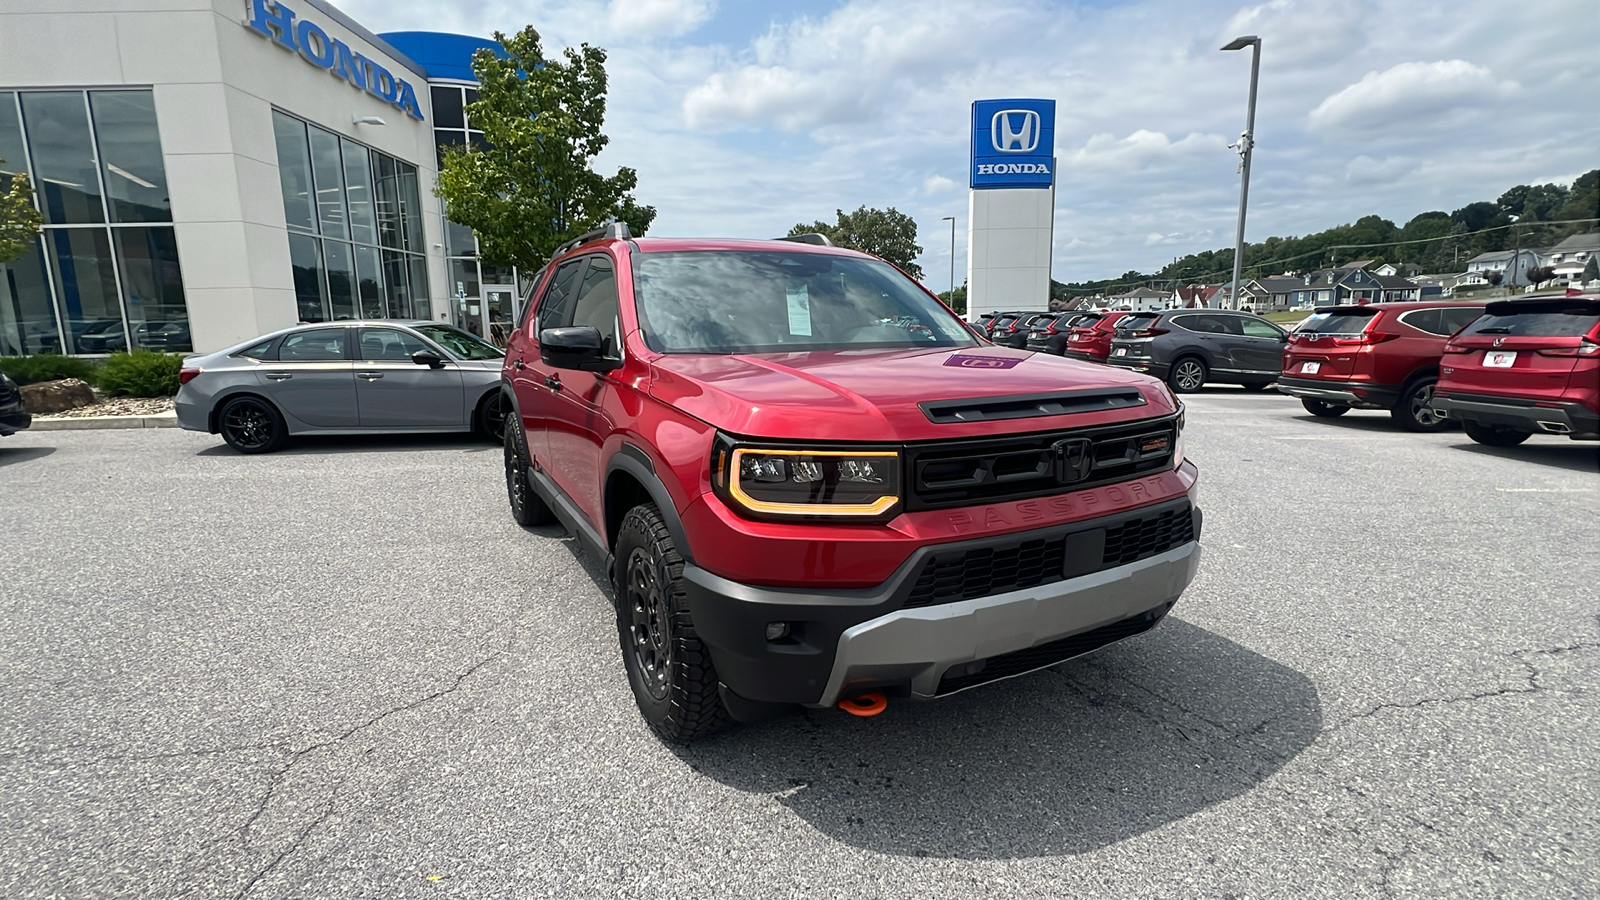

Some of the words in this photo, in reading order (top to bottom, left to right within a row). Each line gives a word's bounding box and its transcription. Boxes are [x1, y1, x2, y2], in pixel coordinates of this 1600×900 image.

[243, 0, 424, 121] HONDA
[977, 163, 1050, 175] HONDA
[949, 476, 1167, 533] PASSPORT
